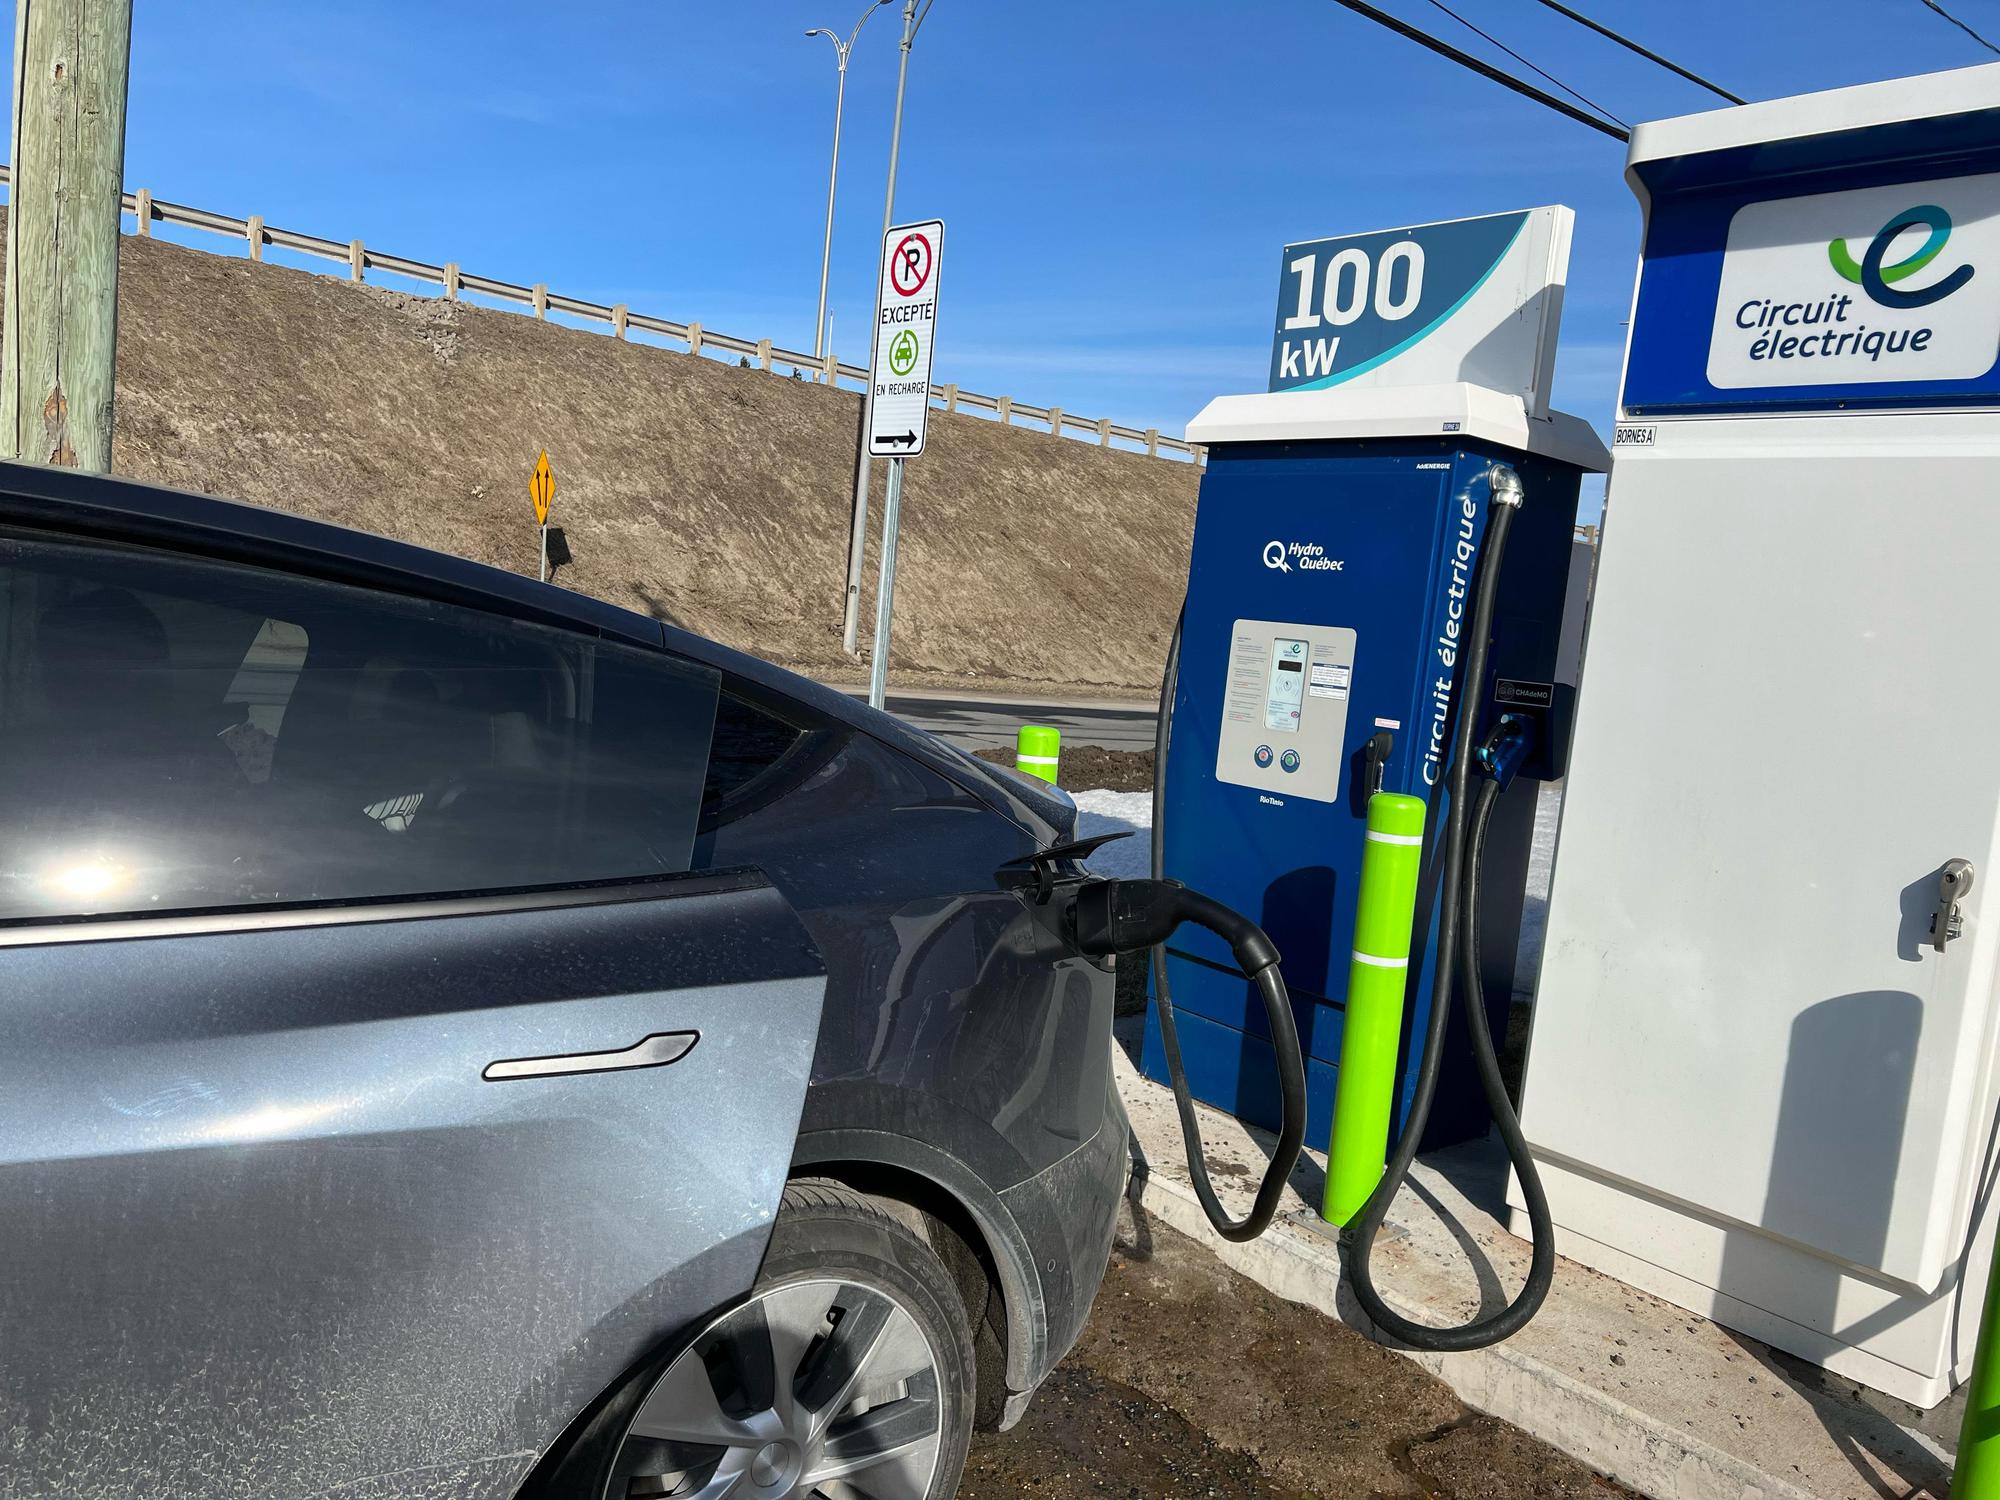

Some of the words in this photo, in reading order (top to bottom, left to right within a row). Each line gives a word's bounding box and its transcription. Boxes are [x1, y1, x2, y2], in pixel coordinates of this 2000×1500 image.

[1284, 241, 1425, 330] 100
[881, 298, 933, 325] EXCEPTÉ
[1735, 293, 1853, 329] Circuit
[1279, 336, 1341, 378] kW
[1749, 325, 1933, 362] électrique
[876, 384, 886, 396] EN
[888, 381, 926, 396] RECHARGE
[1616, 428, 1647, 444] BORNES
[1646, 428, 1653, 444] A
[1288, 542, 1324, 558] Hydro
[1299, 556, 1345, 571] Québec
[1423, 676, 1453, 786] Circuit
[1438, 498, 1476, 668] électrique
[1515, 688, 1548, 699] CHAdeMO
